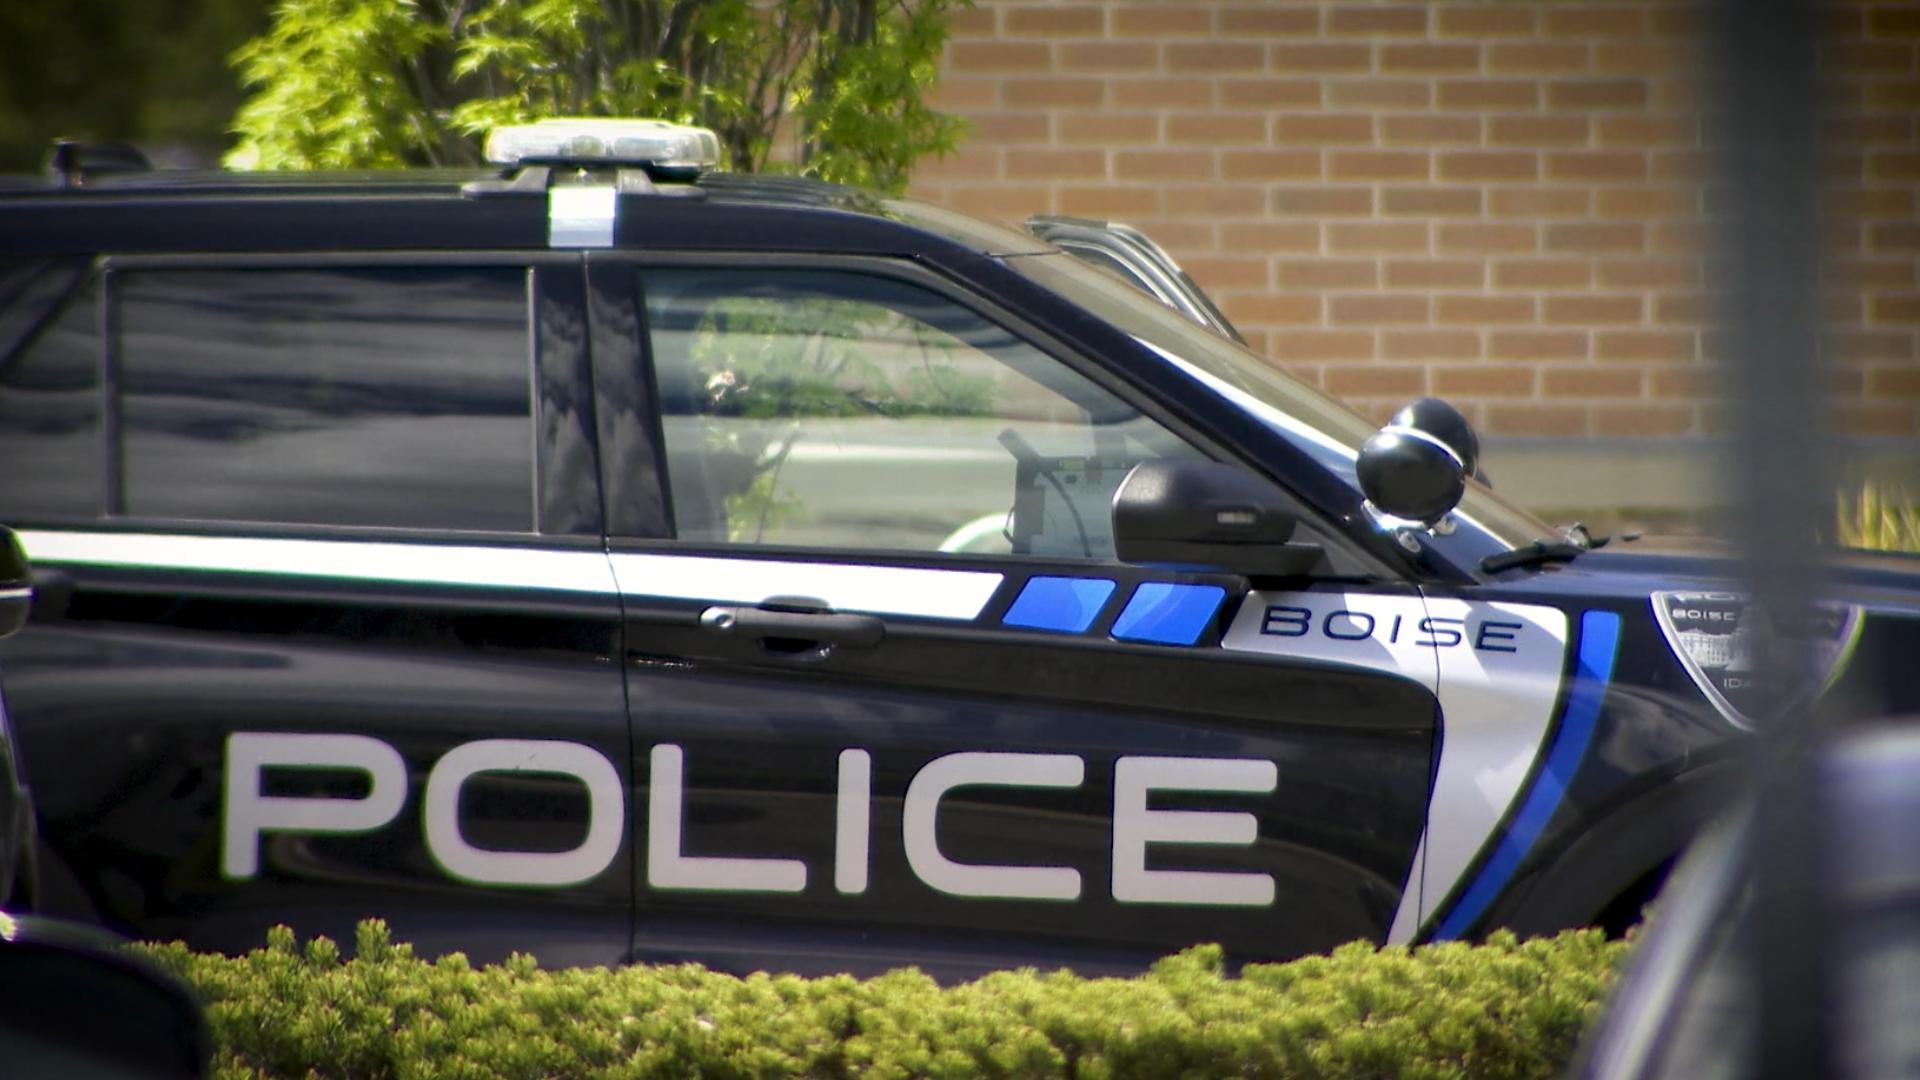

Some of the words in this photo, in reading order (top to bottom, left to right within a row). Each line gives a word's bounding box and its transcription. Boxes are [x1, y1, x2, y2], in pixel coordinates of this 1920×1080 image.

[1260, 606, 1523, 653] BOISE
[1672, 608, 1736, 621] BOISE
[222, 732, 1278, 907] POLICE
